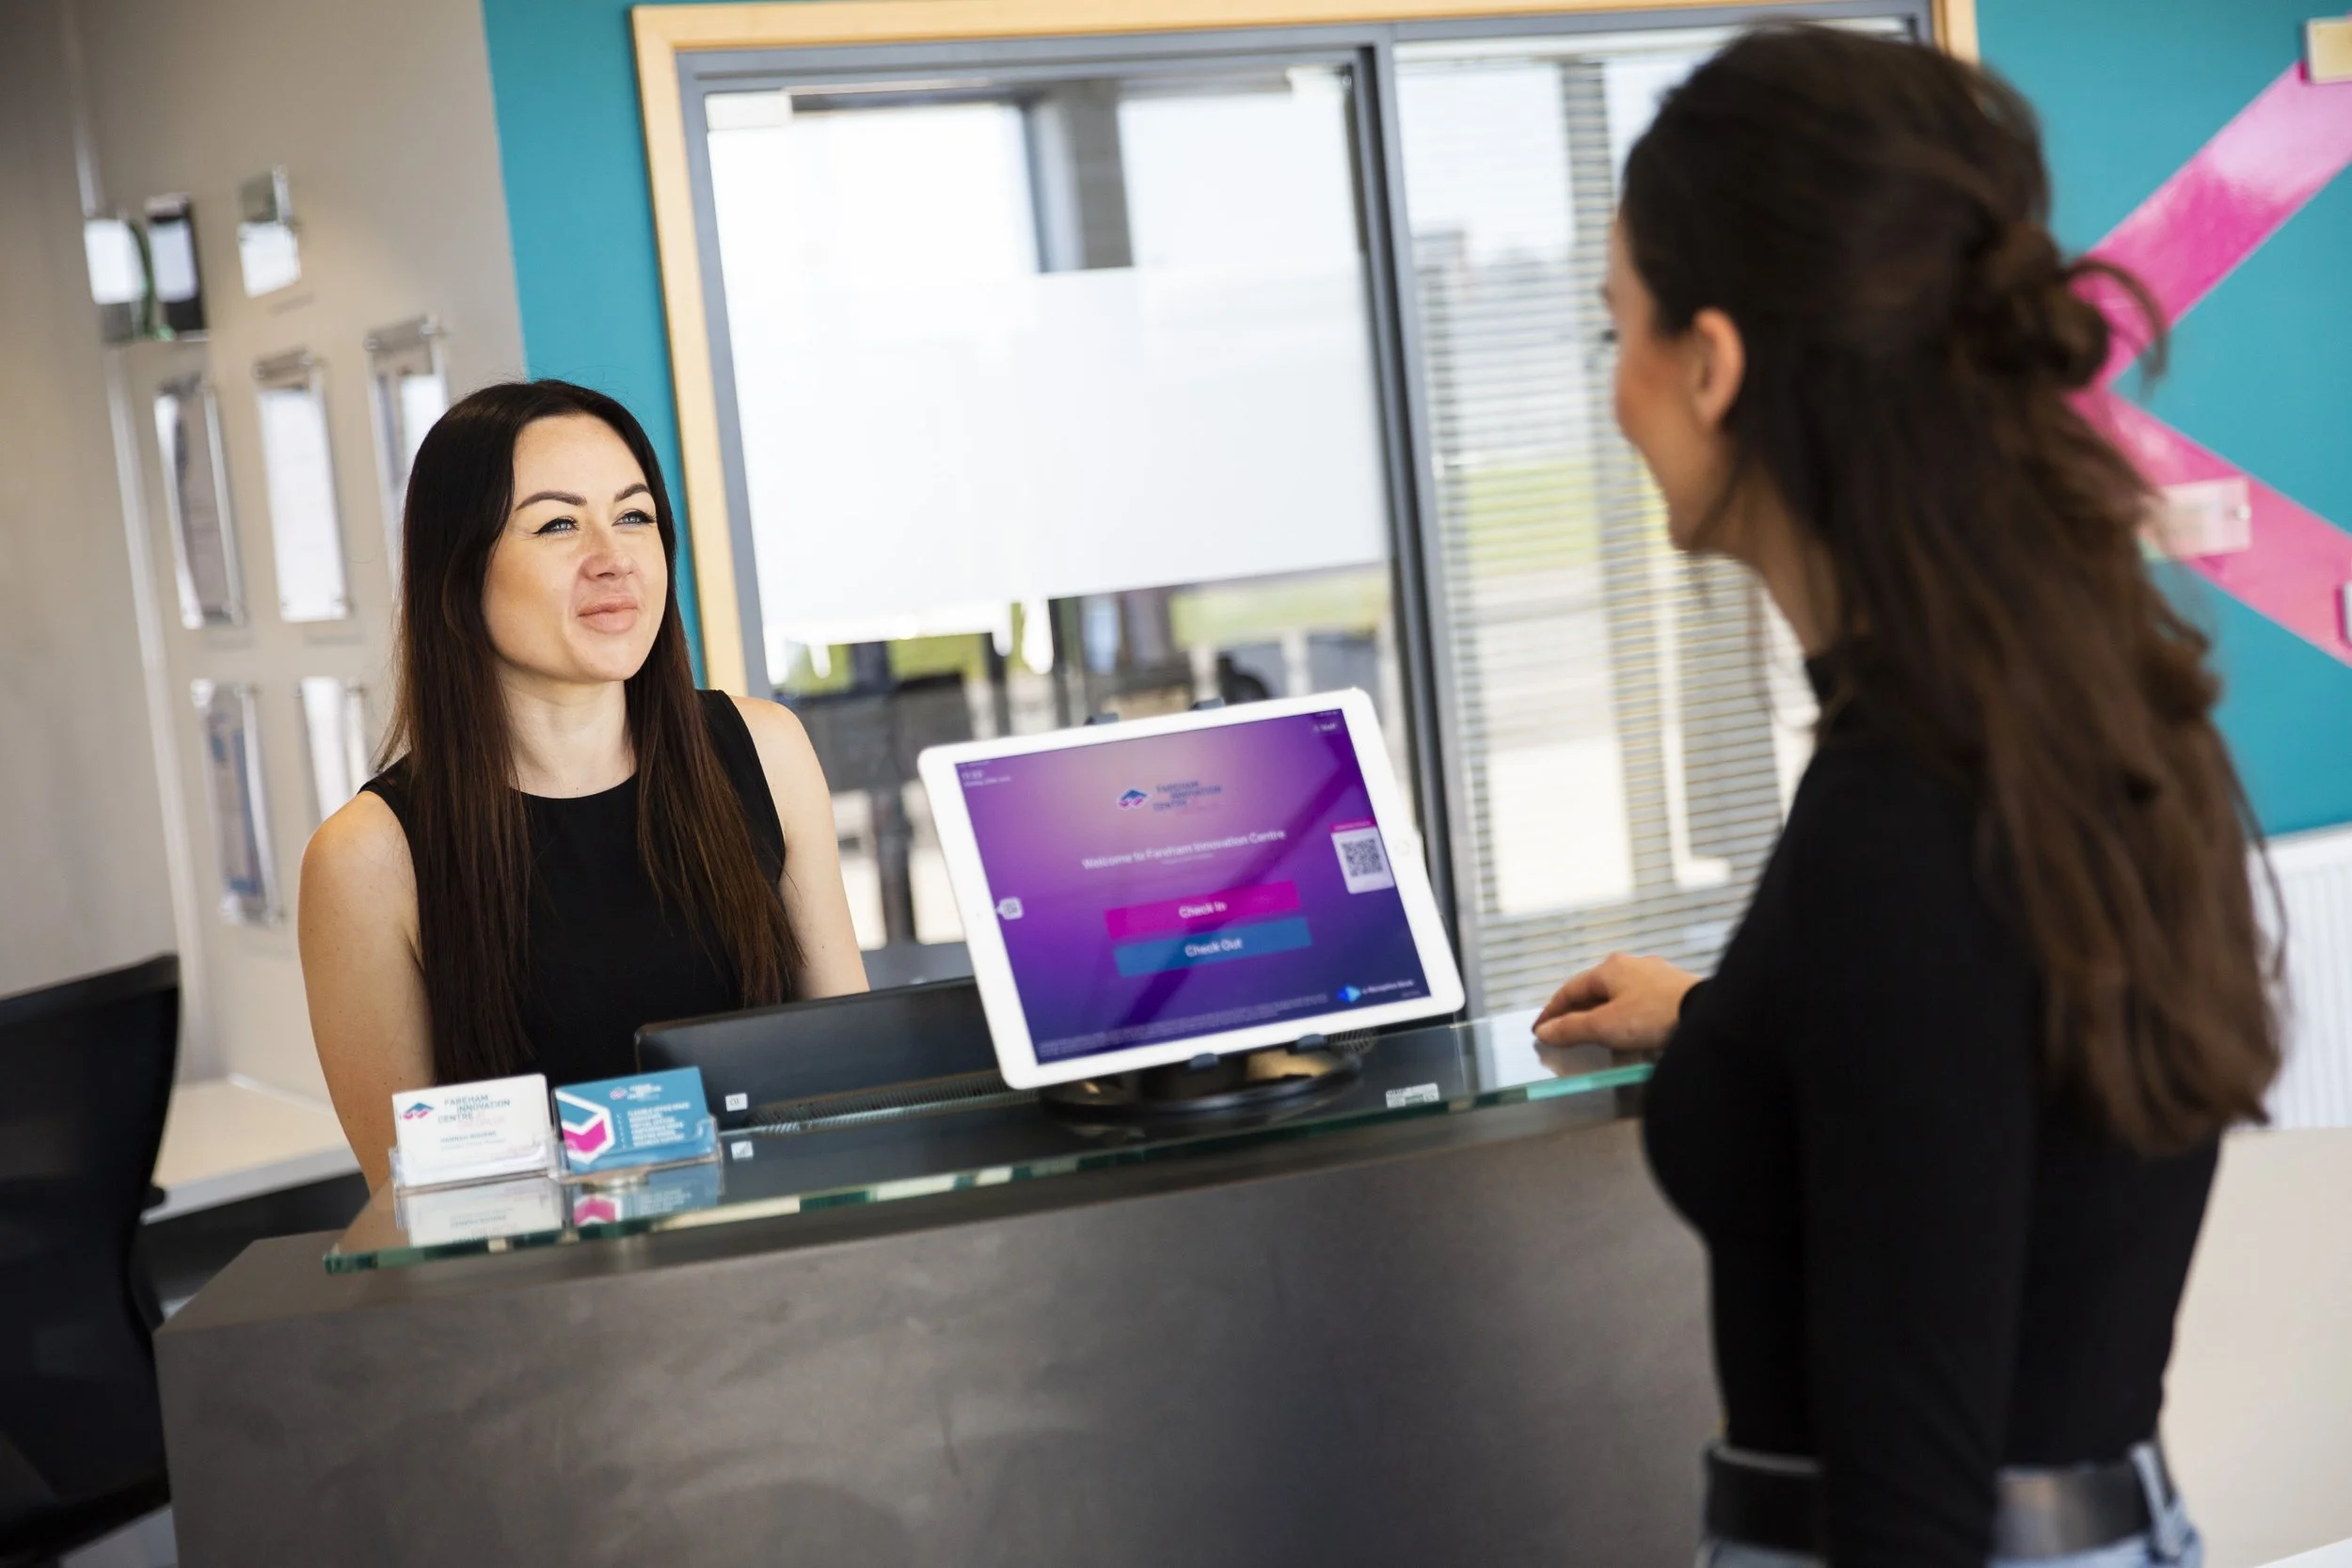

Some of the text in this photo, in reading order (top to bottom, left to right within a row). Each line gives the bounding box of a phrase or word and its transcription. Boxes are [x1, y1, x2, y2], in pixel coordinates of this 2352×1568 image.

[1083, 853, 1131, 869] Welcome
[1133, 850, 1145, 862] to
[1146, 844, 1192, 859] Fareham
[1193, 836, 1248, 852] Innovation
[1248, 830, 1286, 844] Centre
[1179, 900, 1227, 918] Check In
[1185, 938, 1243, 957] Check Out
[444, 1094, 488, 1107] FAREHAM
[456, 1100, 511, 1113] INNOVATION
[438, 1112, 473, 1123] CENTRE
